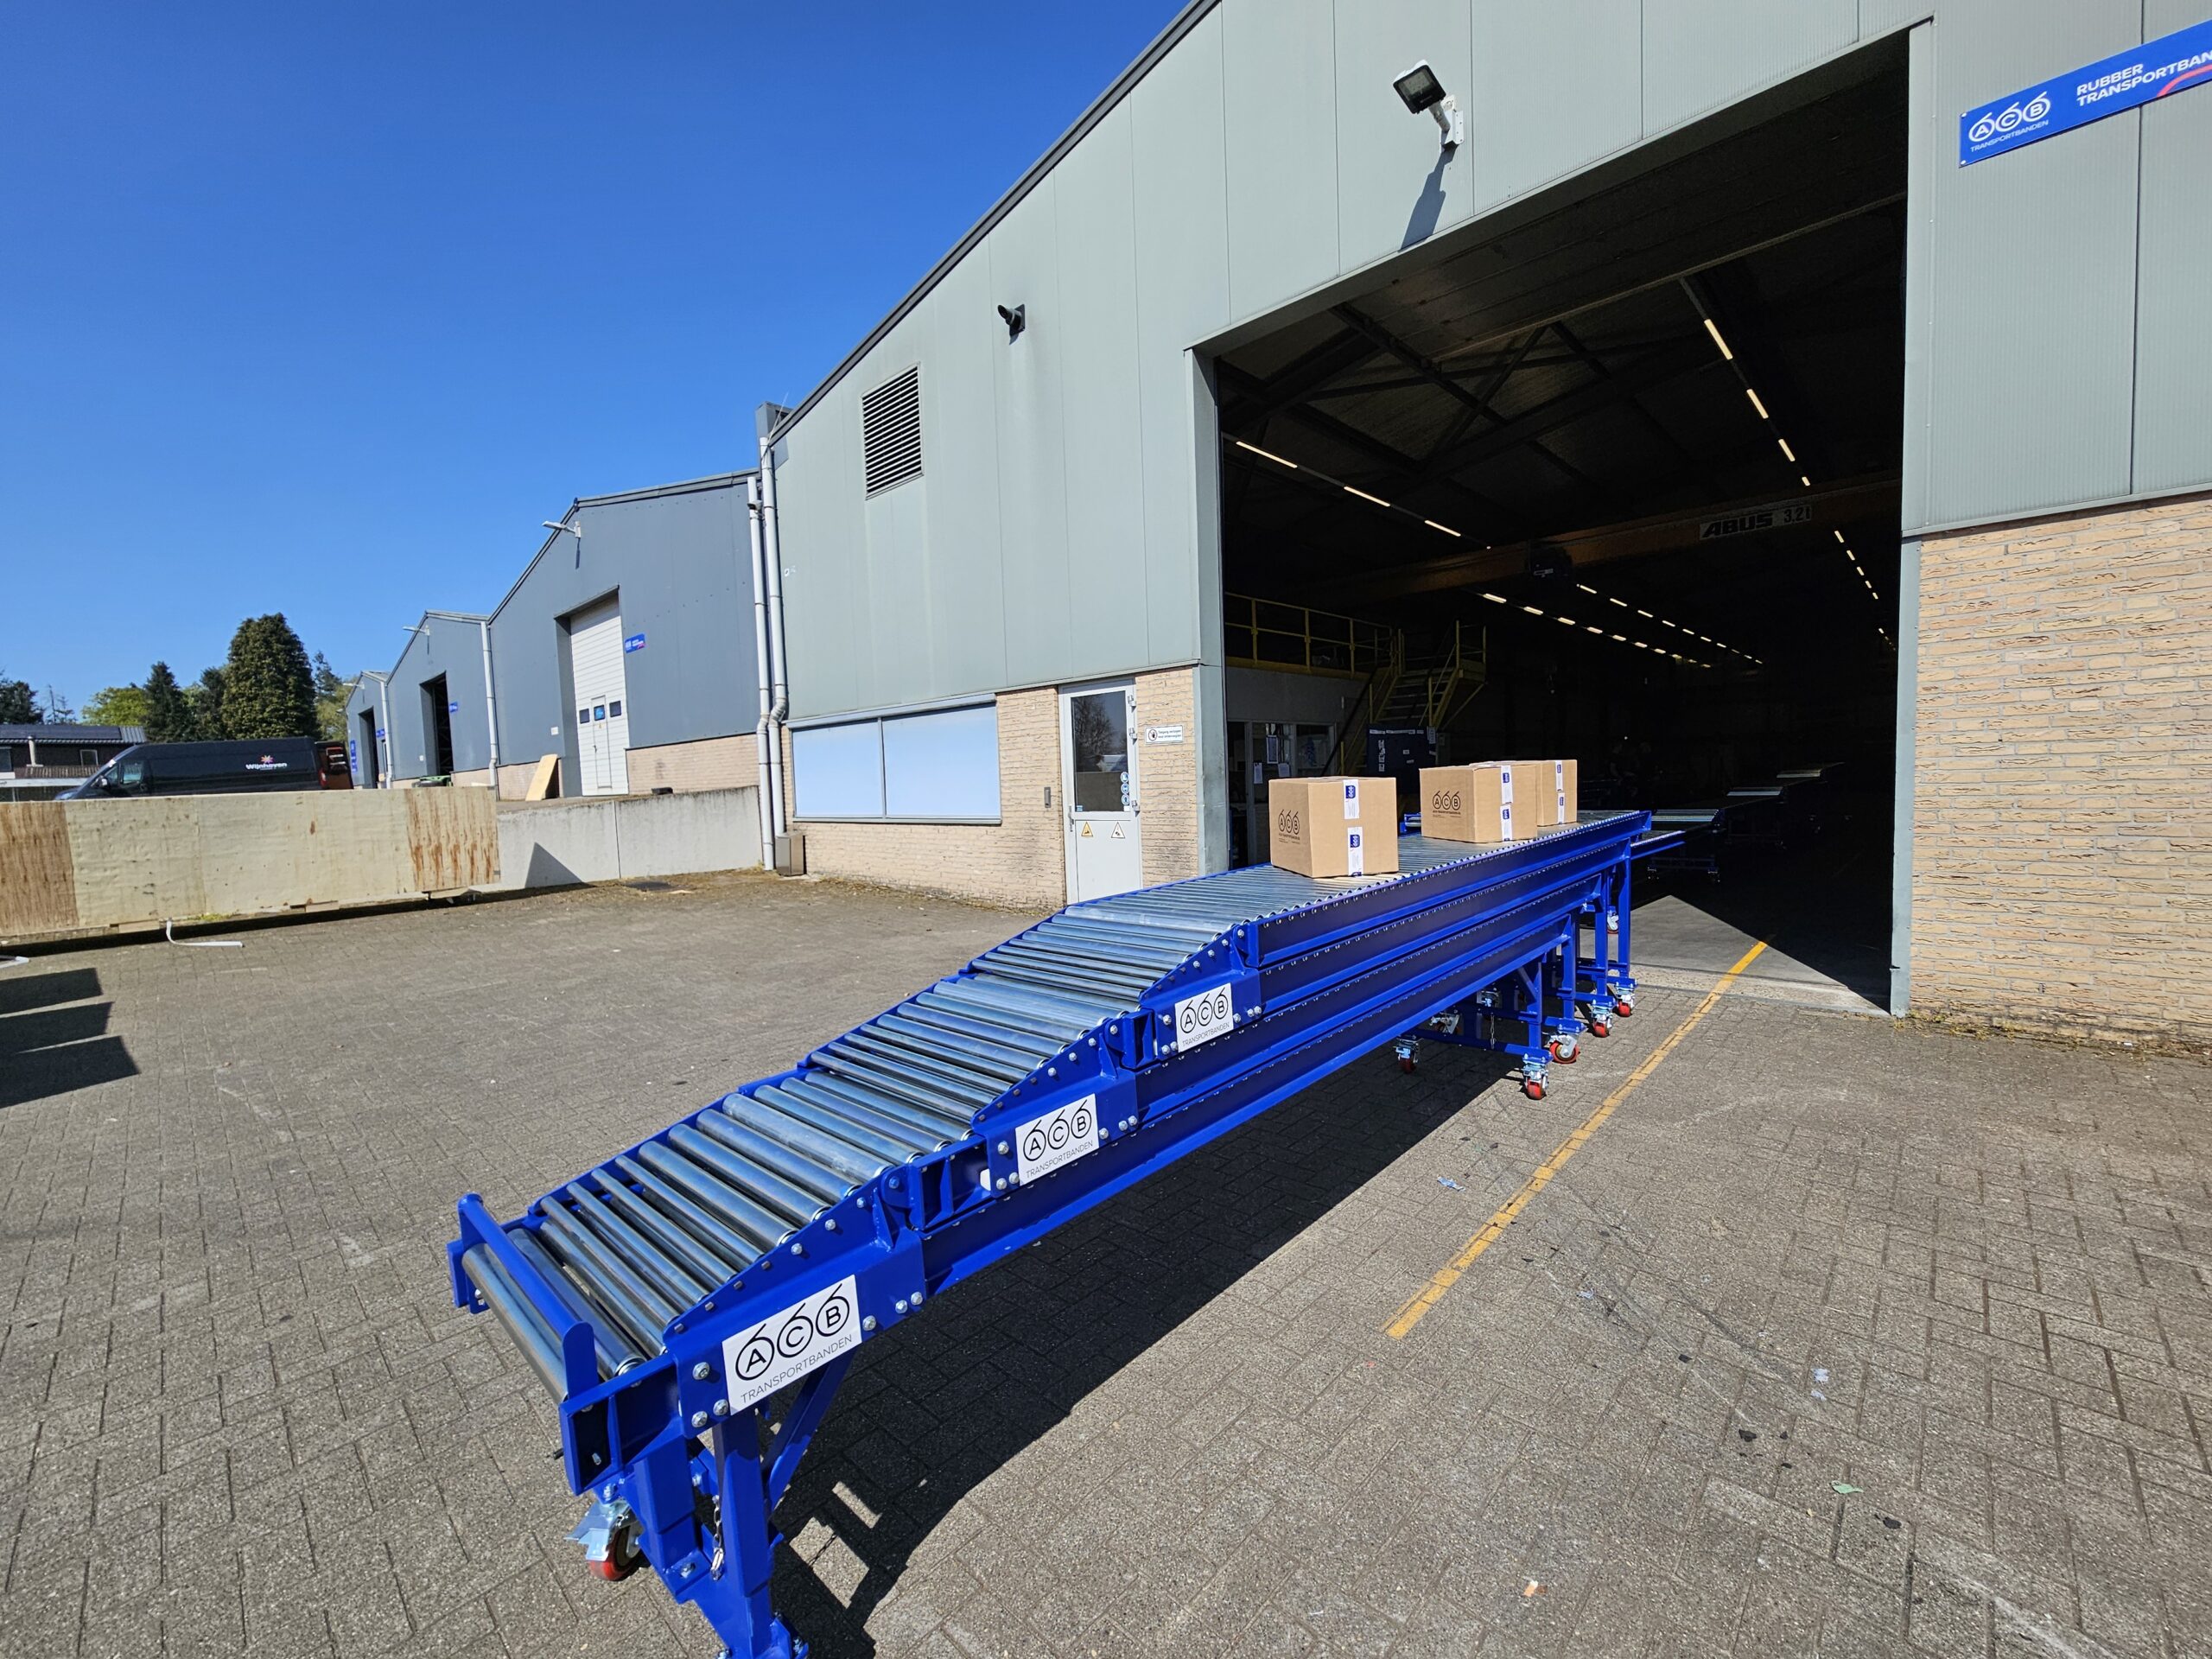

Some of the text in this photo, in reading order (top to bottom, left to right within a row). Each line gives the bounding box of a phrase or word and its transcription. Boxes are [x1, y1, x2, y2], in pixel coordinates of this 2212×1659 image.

[2076, 63, 2144, 96] RUBBER
[1968, 97, 2051, 143] ACB
[1970, 119, 2049, 152] TRANSPORTBANDEN
[1701, 512, 1773, 537] ABUS
[1432, 792, 1461, 810] ACB
[1180, 994, 1229, 1033] ACB
[1182, 1021, 1230, 1047] TRANSPORTBANDEN
[1023, 1108, 1092, 1161] ACB
[1026, 1140, 1093, 1179] TRANSPORTBANDEN
[735, 1295, 850, 1381] ACB
[741, 1334, 852, 1404] TRANSPORTBANDEN
